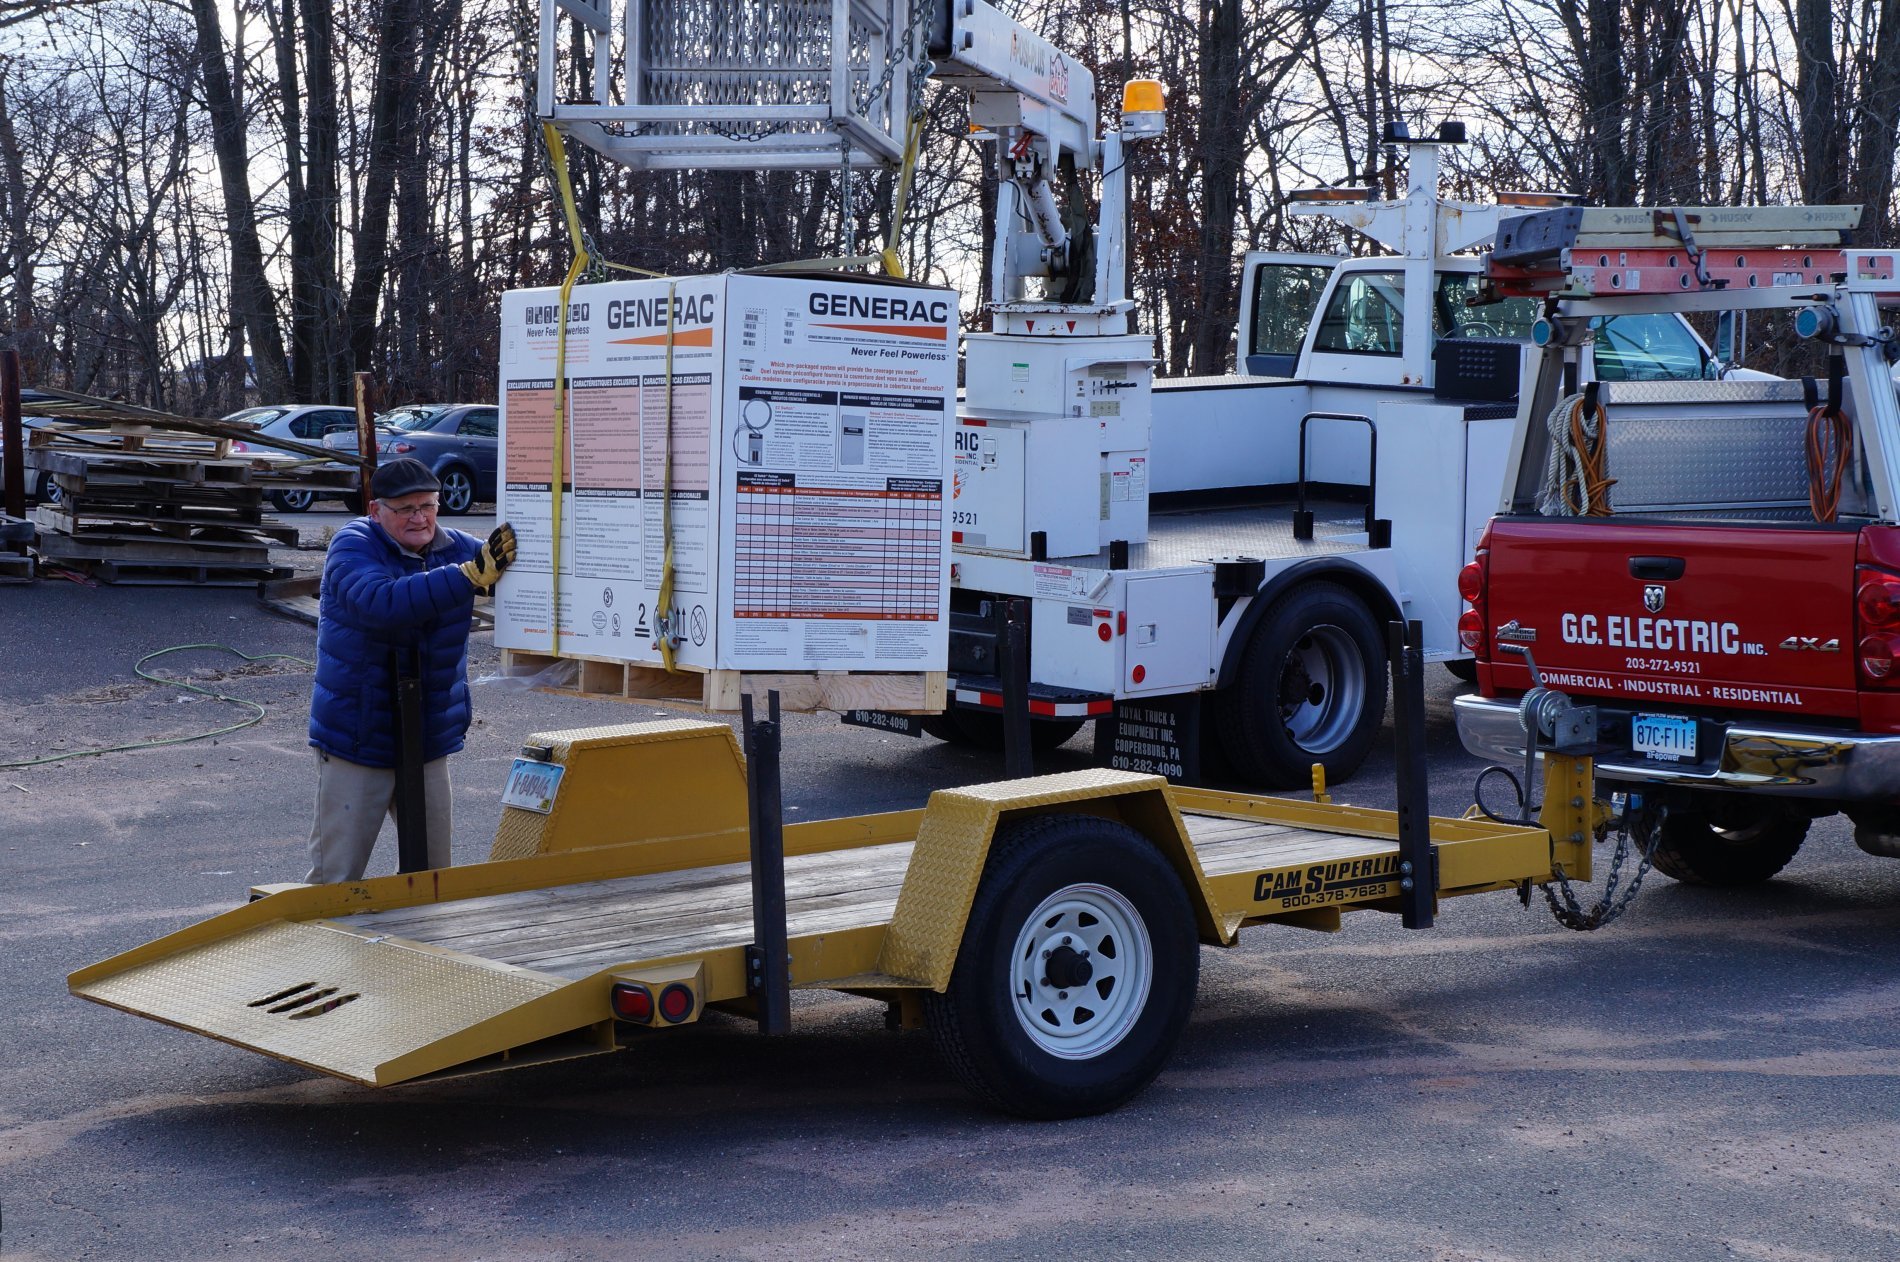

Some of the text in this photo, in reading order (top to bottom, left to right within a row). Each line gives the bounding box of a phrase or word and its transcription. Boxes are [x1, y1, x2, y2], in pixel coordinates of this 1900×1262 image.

[1624, 214, 1653, 223] HUSK
[1720, 213, 1753, 222] HUSKY
[1814, 212, 1846, 222] HUSKY
[608, 294, 714, 330] GENERAC
[810, 292, 948, 323] GENERAC
[526, 328, 544, 338] Never
[545, 326, 558, 336] Feel
[851, 347, 946, 360] Never Feel Powerless
[787, 362, 818, 371] pre-packaged
[574, 378, 612, 387] CARACTÉRISTIQUES
[644, 376, 710, 385] CARACTERICAS EXCLUSIVAS
[639, 603, 646, 625] 2
[1562, 613, 1768, 656] G.C. ELECTRIC INC.
[1625, 657, 1700, 674] 203-272-9521
[1533, 672, 1802, 705] OMMERCIAL INDUSTRIAL RESIDENTIAL
[855, 710, 909, 731] 610-282-4090
[1120, 706, 1176, 726] ROYAL TRUCK &
[1120, 723, 1176, 743] EQUIPMENT INC.
[1115, 739, 1180, 761] COOPERSBURG, PA
[1647, 750, 1680, 761] aFepower
[1112, 755, 1182, 777] 610-282-4090
[1305, 856, 1400, 894] SUPERLIN
[1282, 884, 1386, 908] 800-378-7623
